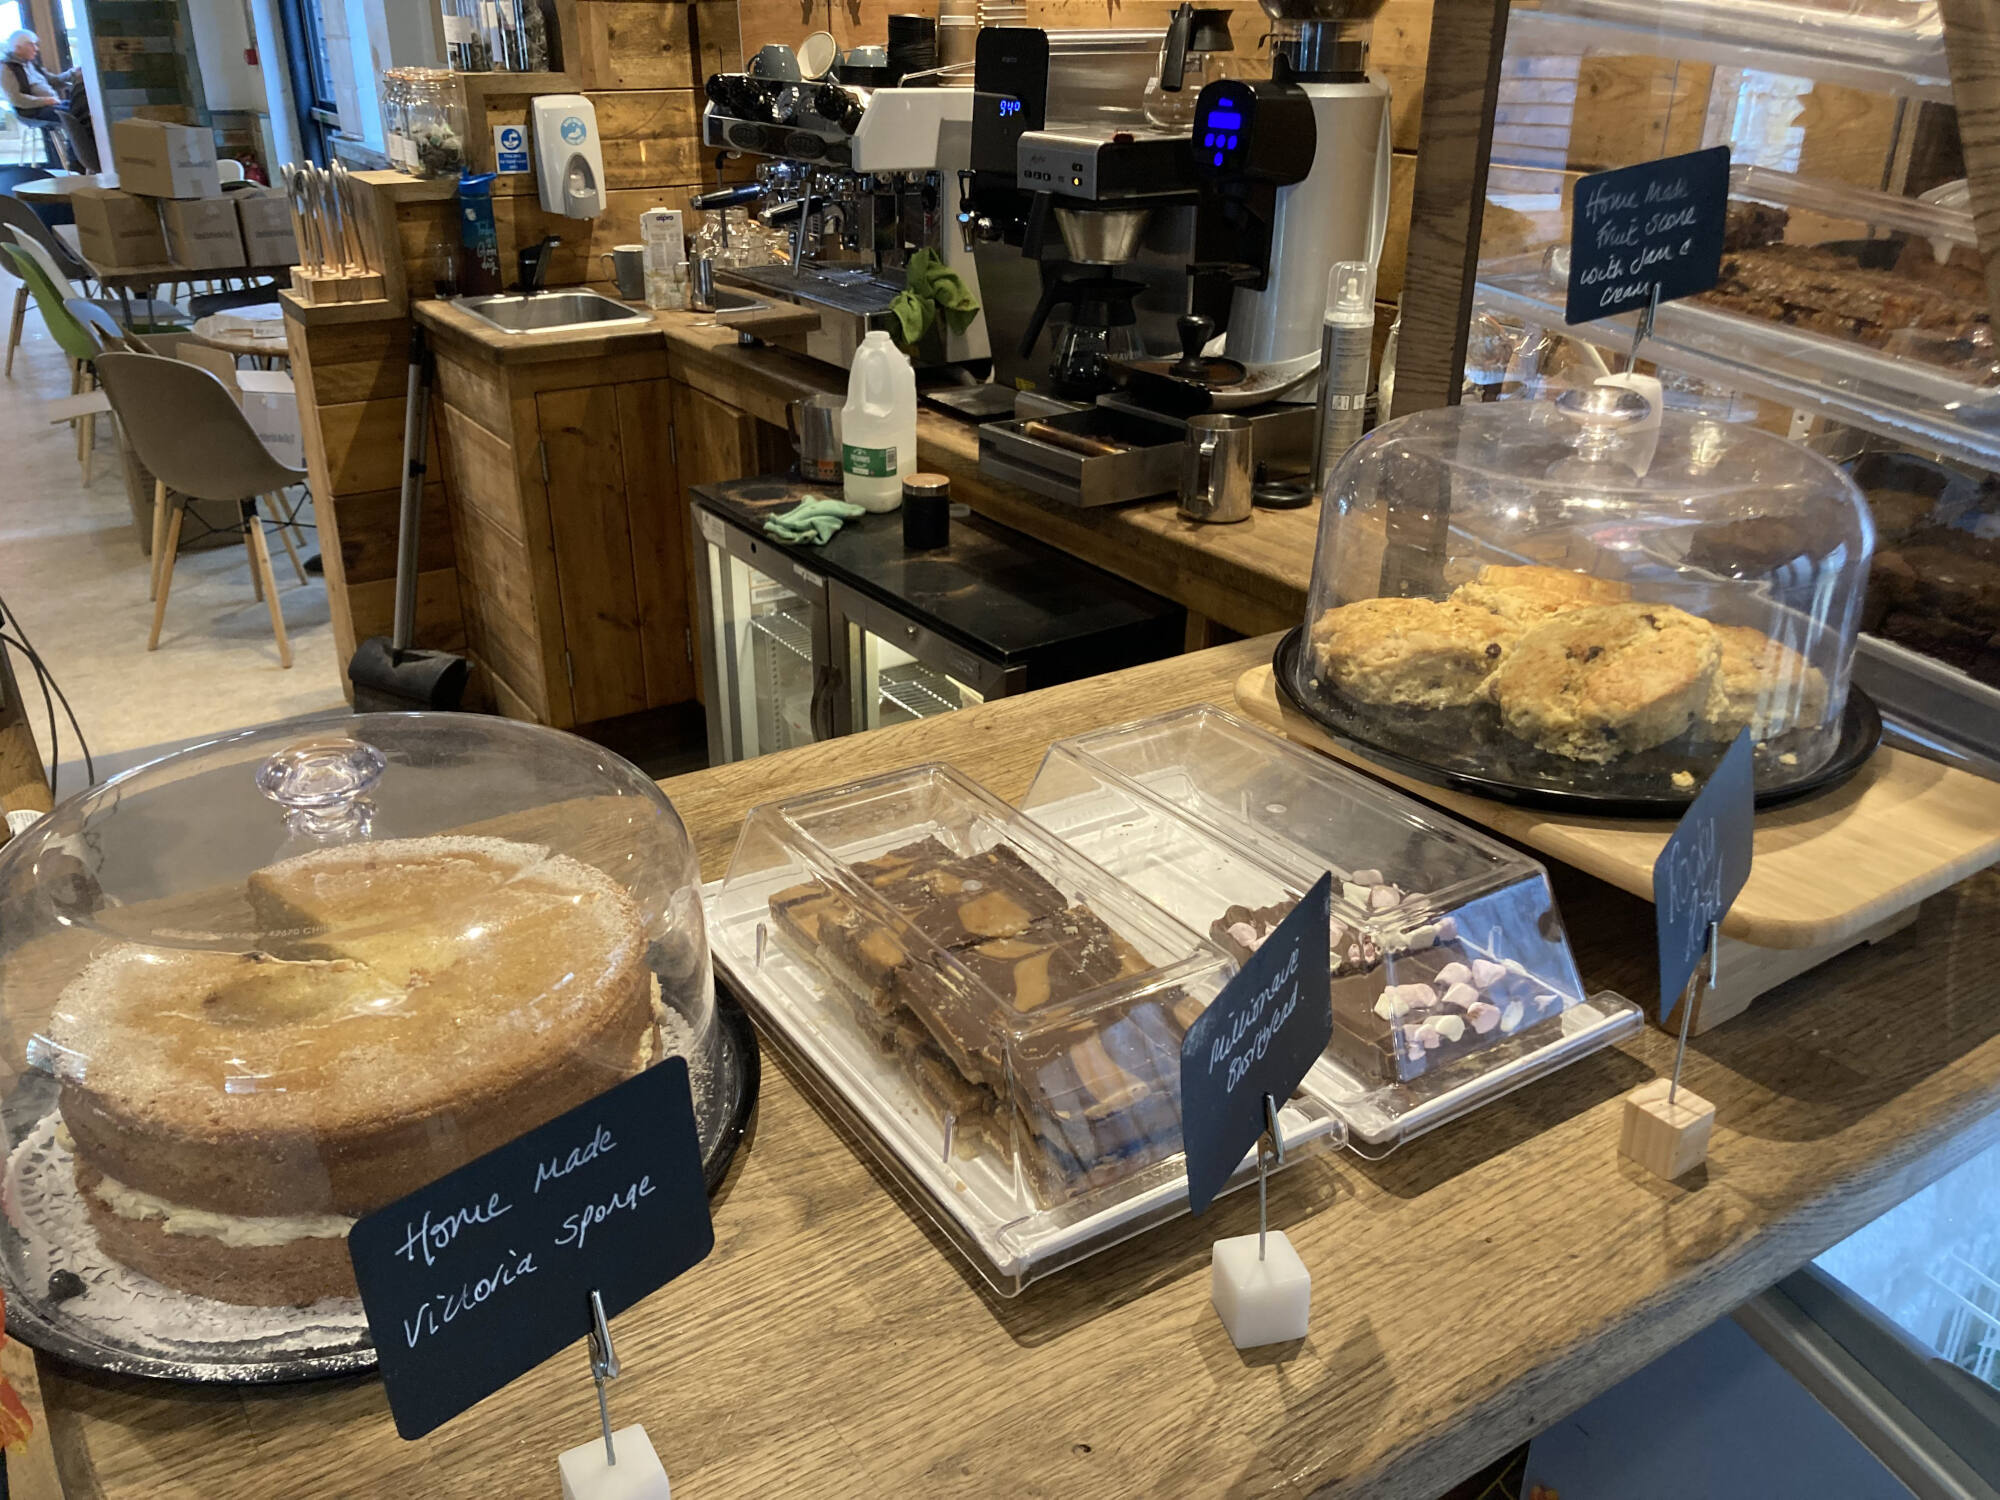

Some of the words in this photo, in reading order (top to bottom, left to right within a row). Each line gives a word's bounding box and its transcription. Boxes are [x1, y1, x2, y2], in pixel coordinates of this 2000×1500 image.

[1585, 180, 1640, 225] Home
[1580, 255, 1624, 285] with
[394, 1192, 512, 1266] Home
[403, 1249, 538, 1348] Victoria
